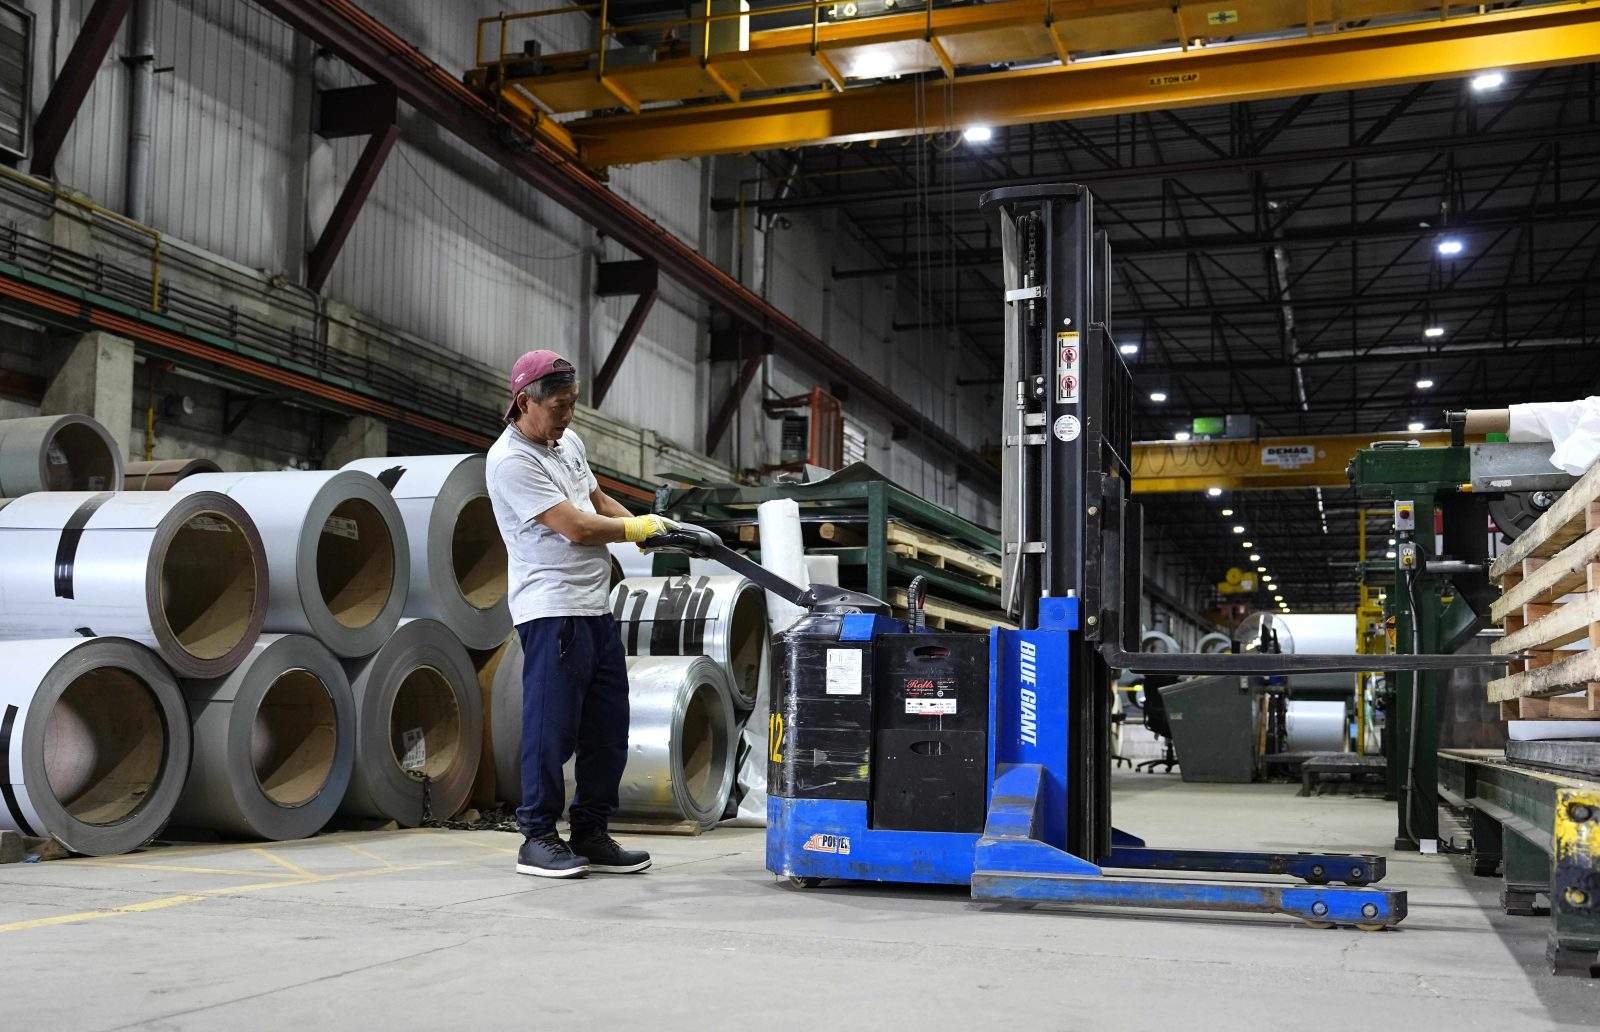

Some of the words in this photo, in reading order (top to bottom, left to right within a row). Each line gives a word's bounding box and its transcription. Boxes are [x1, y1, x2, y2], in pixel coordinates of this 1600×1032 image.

[1164, 76, 1179, 84] TON
[1182, 74, 1198, 82] CAP
[1267, 447, 1308, 455] DEMAG
[1020, 640, 1036, 687] BLUE
[770, 713, 783, 763] 12
[1020, 688, 1037, 747] GIANT
